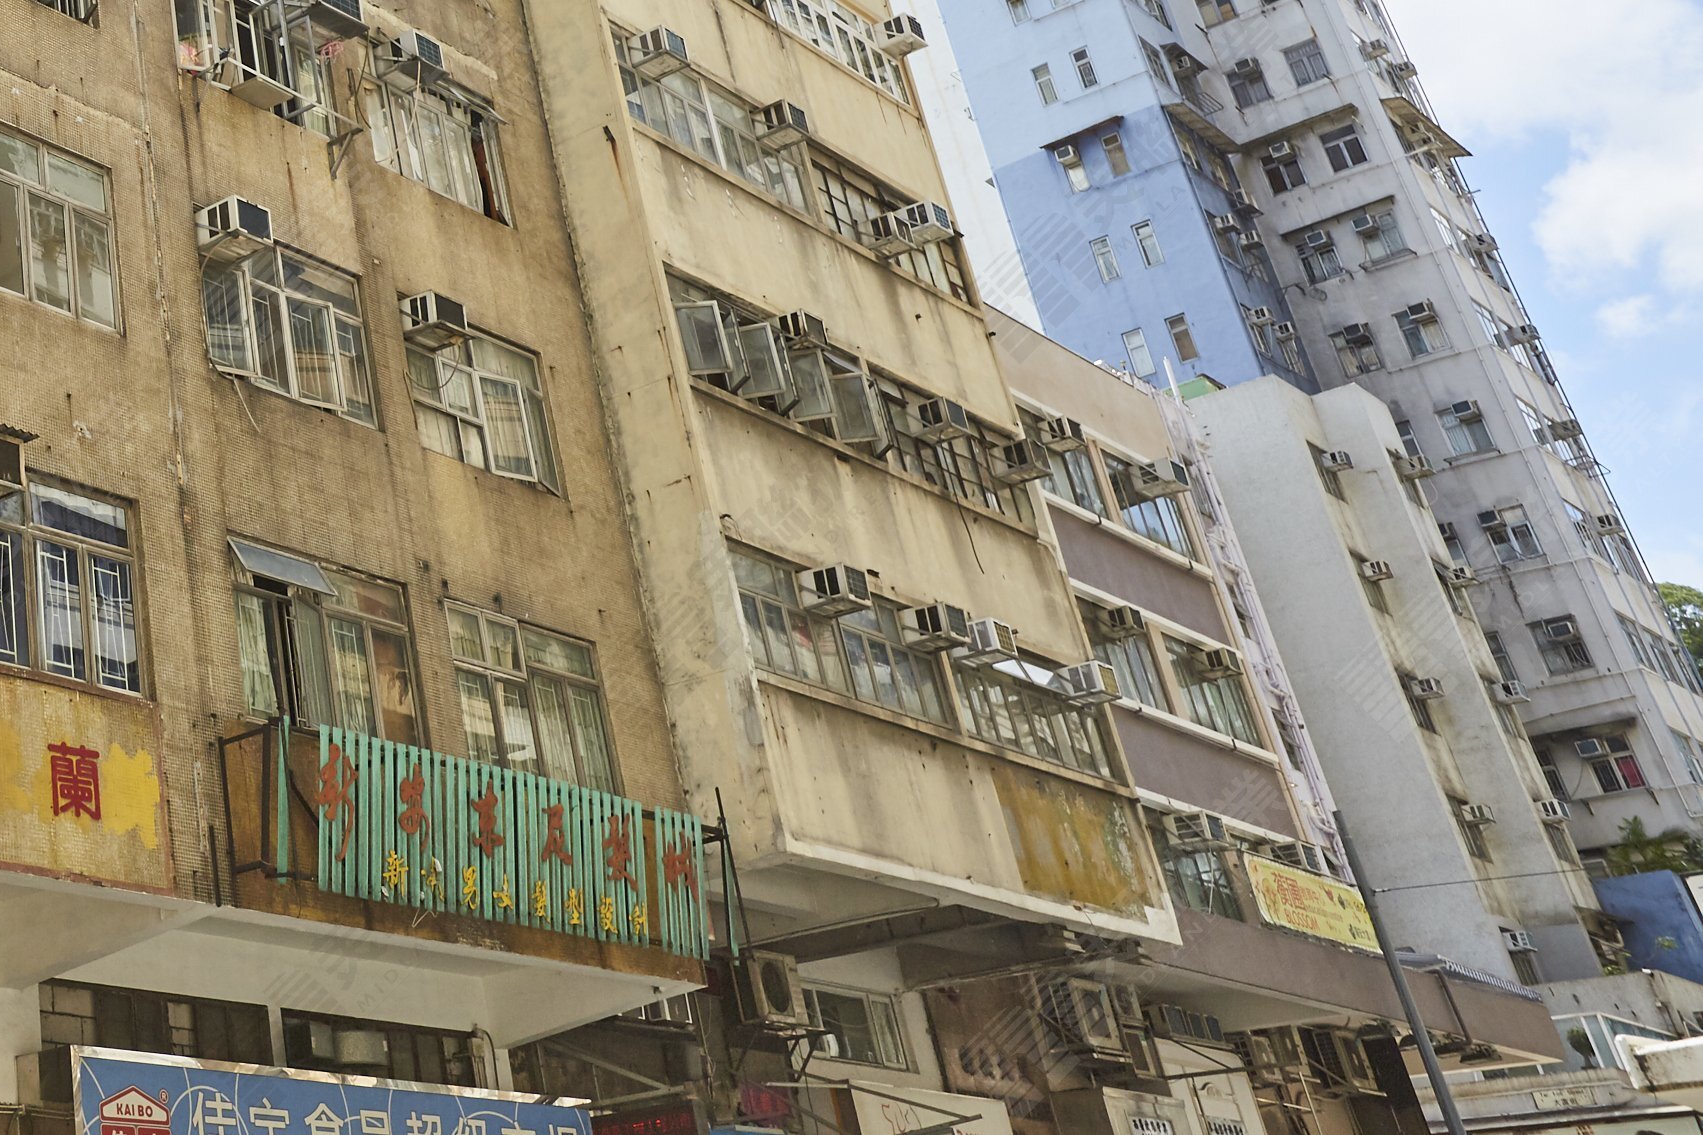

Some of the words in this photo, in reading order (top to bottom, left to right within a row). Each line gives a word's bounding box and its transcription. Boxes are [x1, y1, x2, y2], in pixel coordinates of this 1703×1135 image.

[1284, 909, 1321, 934] BLOSSOM
[116, 1103, 135, 1116] KAI
[138, 1104, 153, 1118] BO
